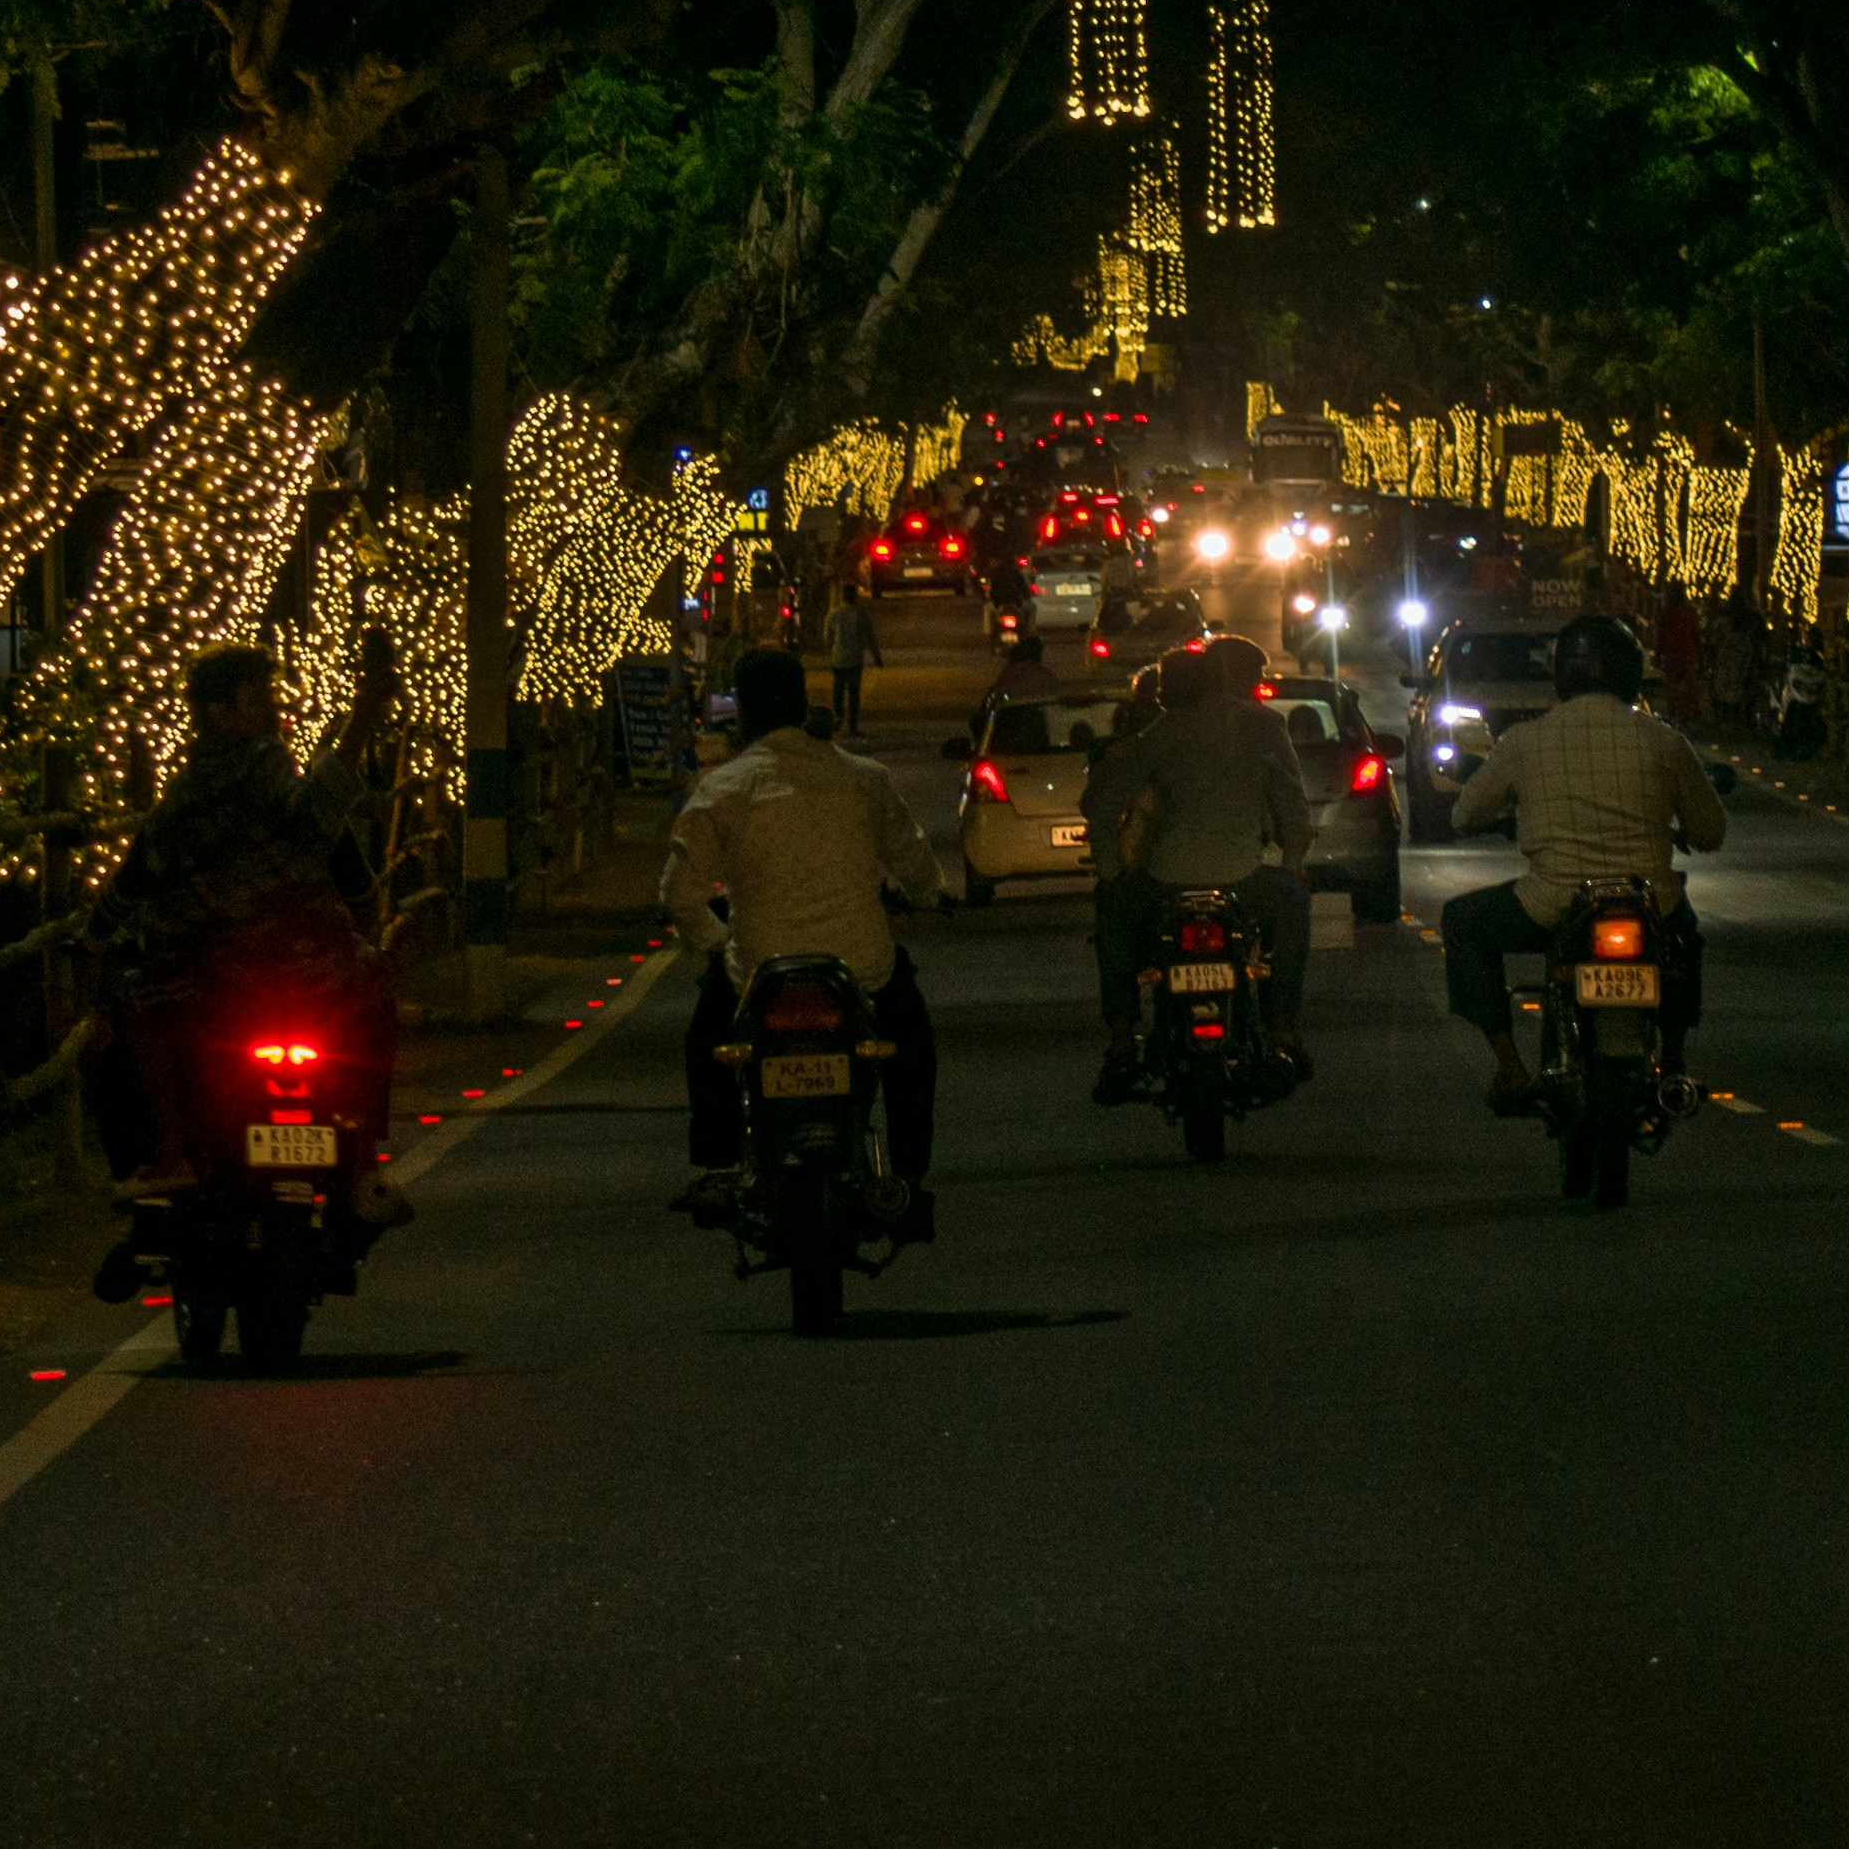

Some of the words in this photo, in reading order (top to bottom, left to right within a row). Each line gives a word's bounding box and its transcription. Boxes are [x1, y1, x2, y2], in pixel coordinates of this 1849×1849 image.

[1532, 578, 1582, 594] NOW
[1532, 594, 1583, 608] OPEN
[271, 1144, 327, 1163] R1672
